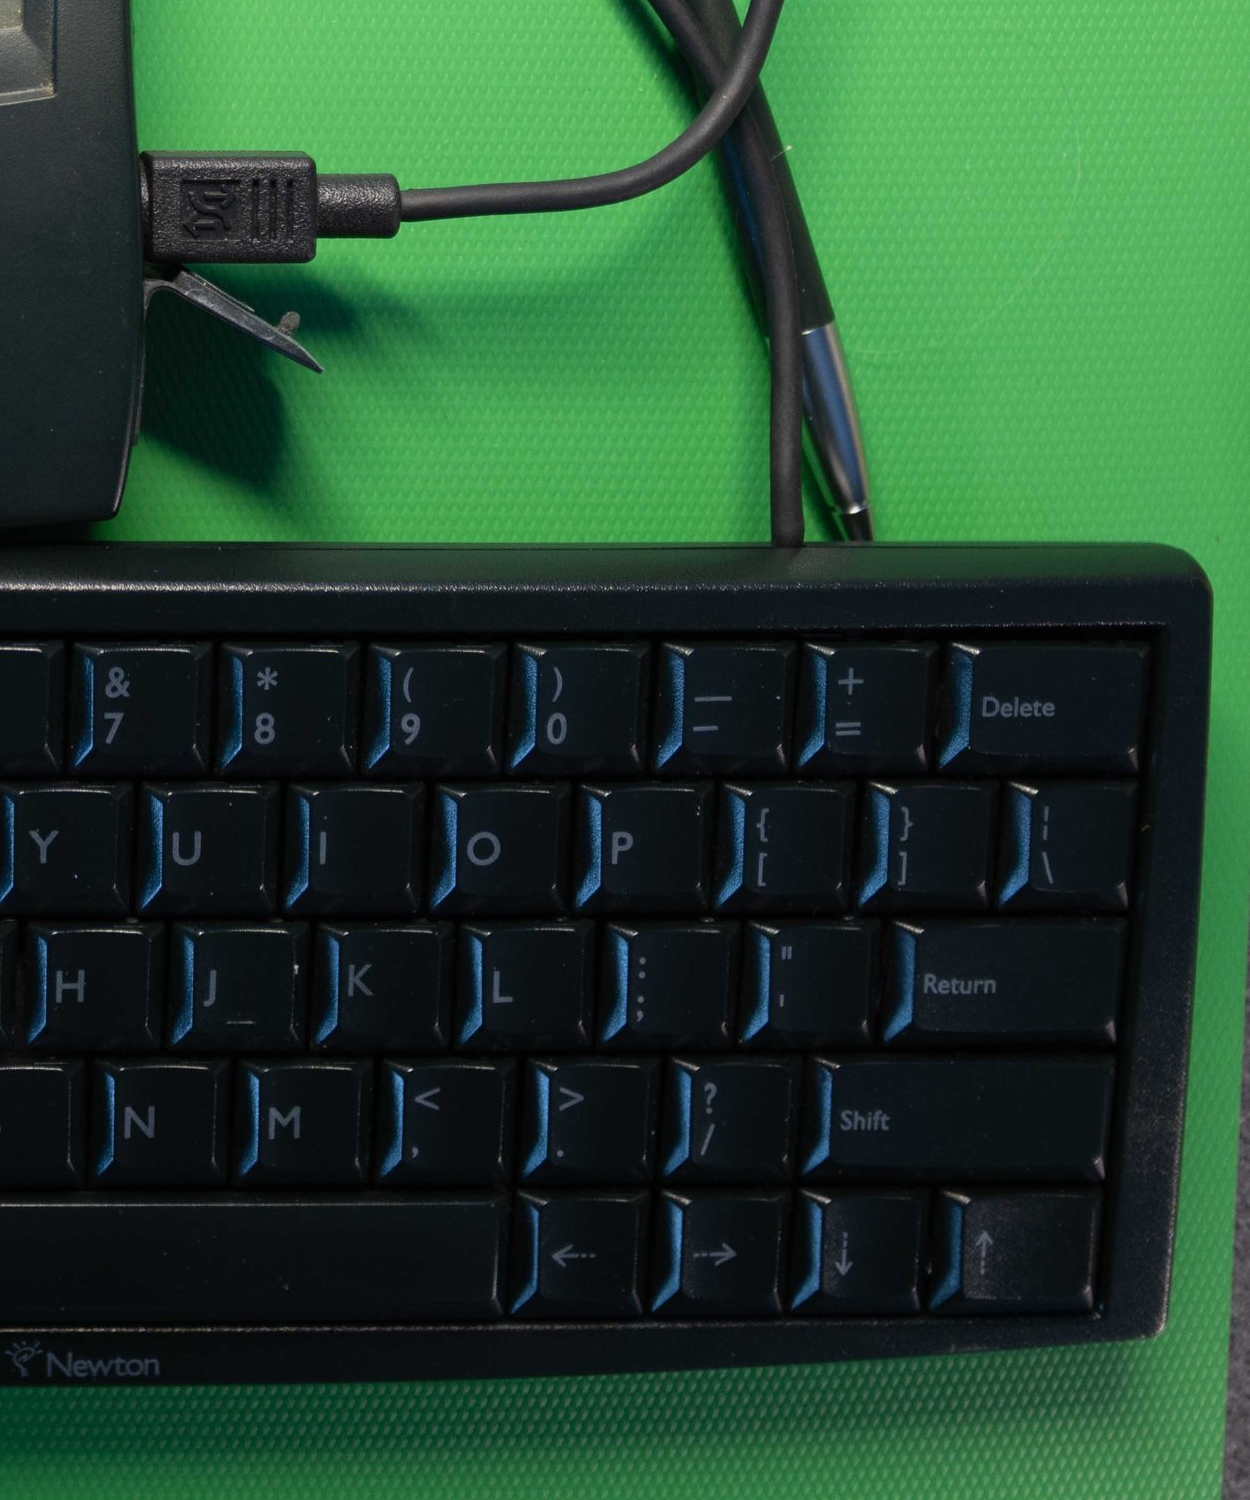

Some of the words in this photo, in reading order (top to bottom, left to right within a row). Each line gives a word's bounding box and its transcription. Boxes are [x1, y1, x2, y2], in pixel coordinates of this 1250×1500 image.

[105, 667, 130, 698] &
[838, 668, 863, 695] +
[982, 697, 1056, 719] Delete
[103, 712, 124, 744] 7
[254, 713, 275, 745] 8
[401, 713, 421, 745] 9
[29, 830, 59, 864] Y
[172, 831, 202, 866] U
[467, 831, 501, 866] O
[612, 832, 634, 865] P
[56, 970, 85, 1002] H
[202, 970, 216, 1007] J
[349, 964, 373, 997] K
[493, 971, 513, 1003] L
[923, 973, 997, 995] Return
[703, 1083, 717, 1114] ?
[124, 1106, 155, 1139] N
[268, 1107, 301, 1140] M
[840, 1110, 890, 1131] Shift
[48, 1353, 160, 1377] Newton
